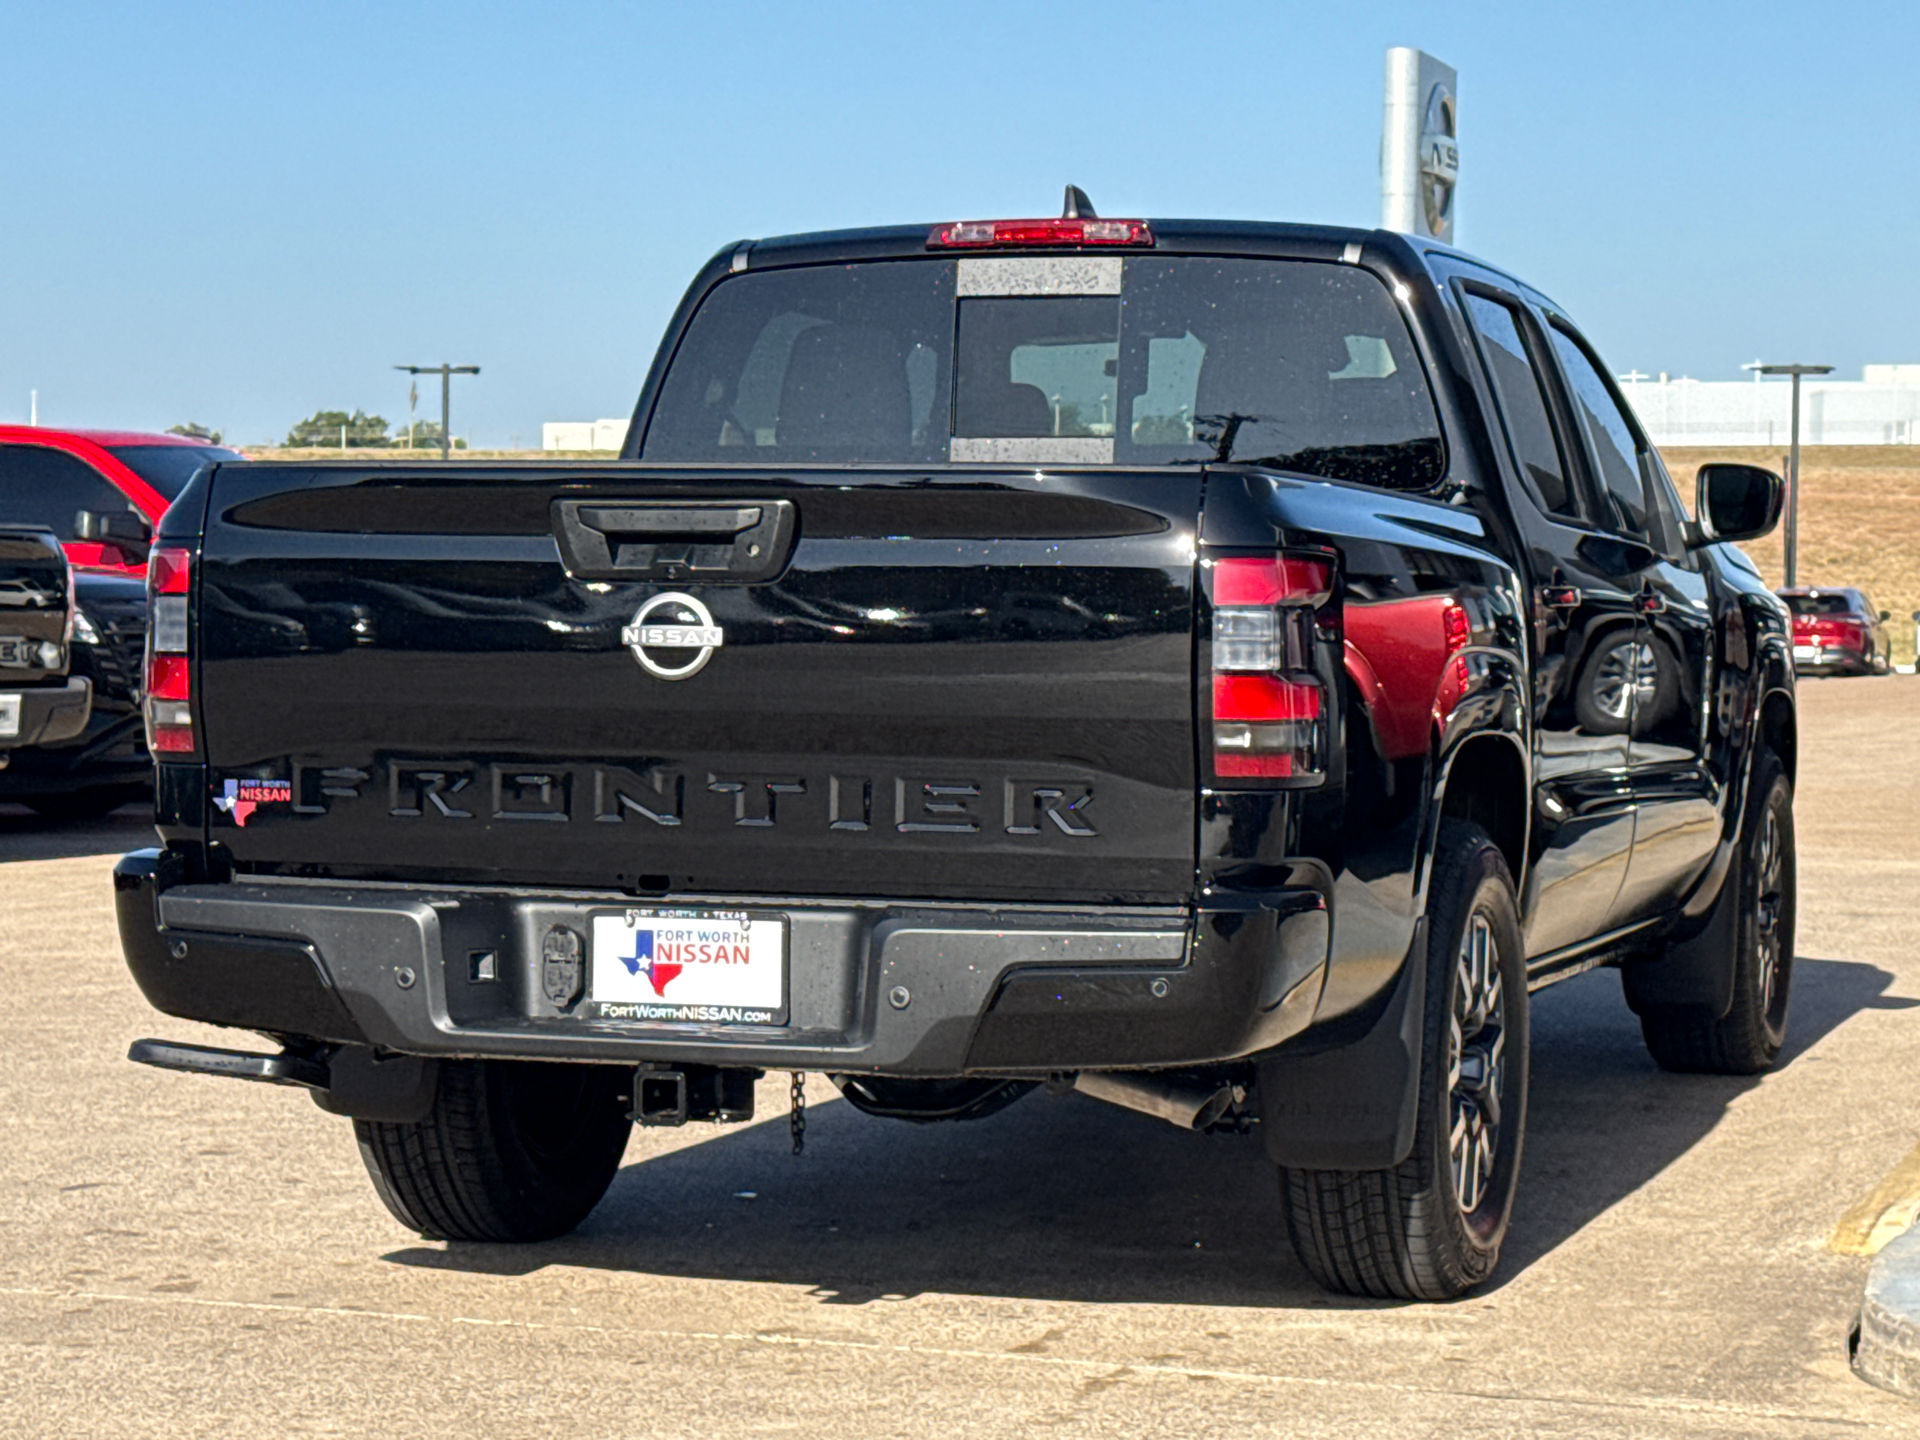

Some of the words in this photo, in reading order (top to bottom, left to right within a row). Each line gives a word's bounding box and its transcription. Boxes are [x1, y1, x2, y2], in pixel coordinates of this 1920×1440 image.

[623, 628, 719, 644] NISSAN
[240, 780, 260, 788] FORT
[262, 780, 291, 788] WORTH
[240, 788, 291, 801] NISSAN
[290, 757, 1098, 836] FRONTIER
[658, 909, 697, 919] WORTH
[713, 910, 748, 920] TEXAS
[656, 929, 693, 942] FORT
[697, 930, 750, 943] WORTH
[656, 943, 750, 964] NISSAN
